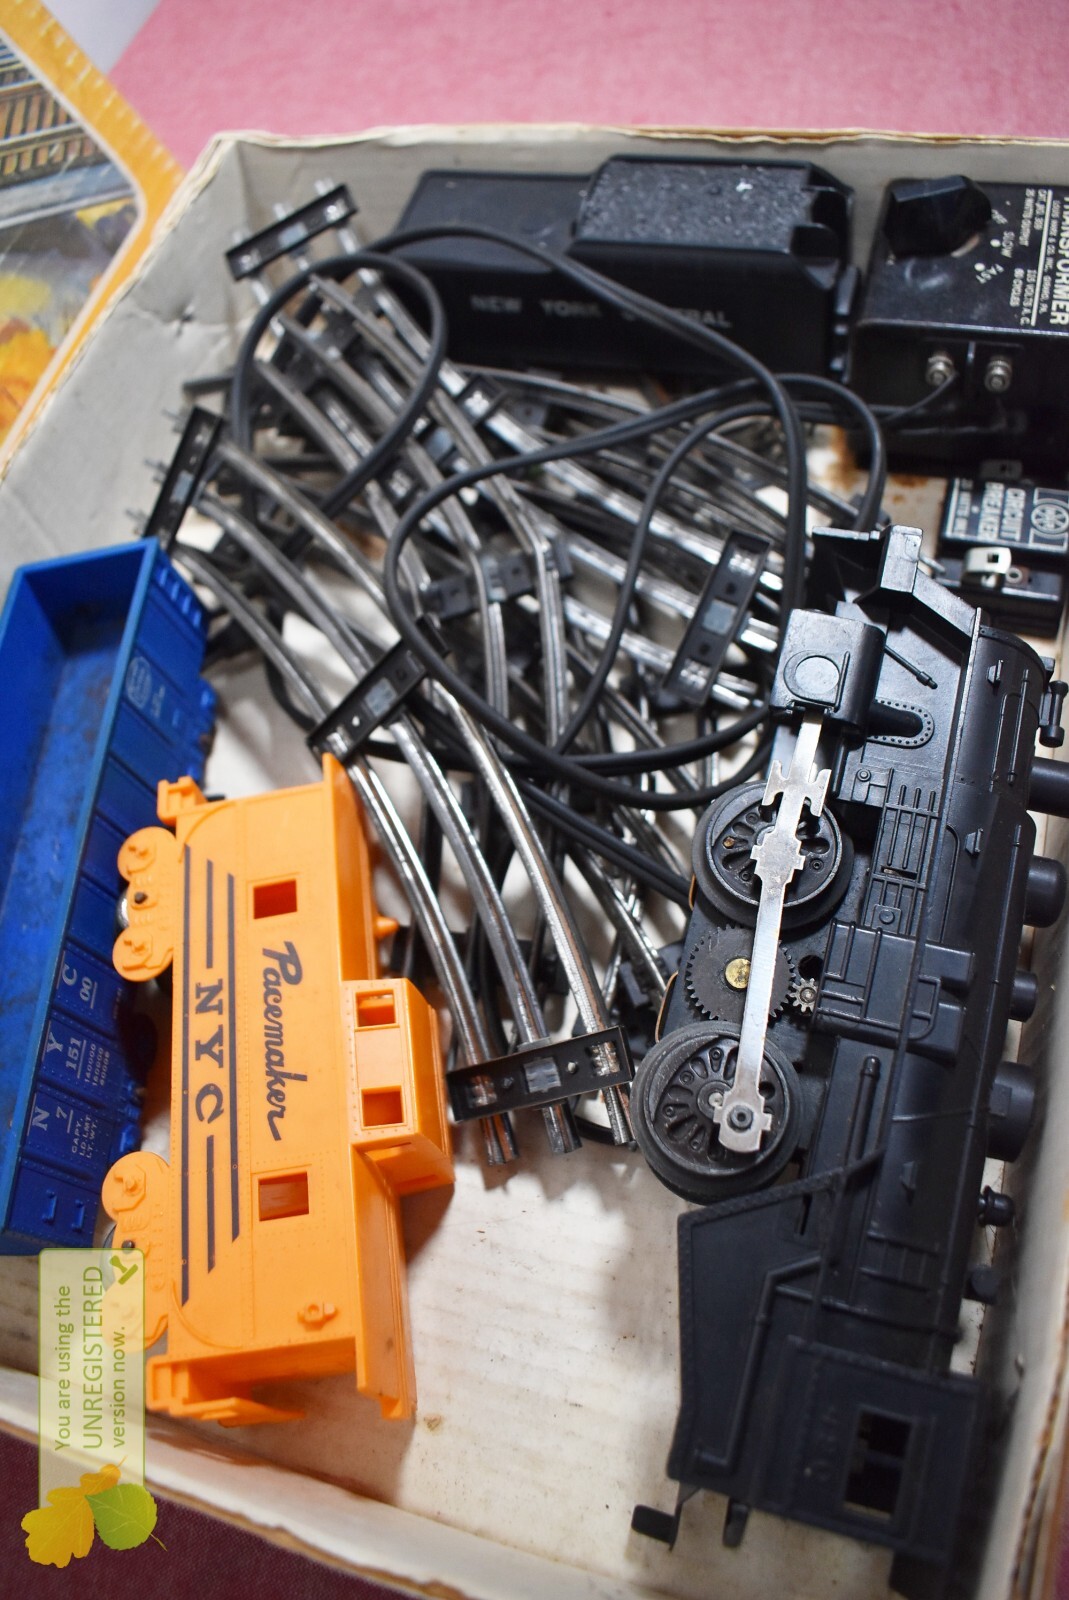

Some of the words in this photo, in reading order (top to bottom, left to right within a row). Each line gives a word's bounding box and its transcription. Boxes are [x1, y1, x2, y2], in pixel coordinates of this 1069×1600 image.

[1001, 230, 1016, 258] SLOW
[1050, 196, 1069, 325] NSFORMER
[978, 481, 1005, 540] BREAKER
[1000, 487, 1027, 541] CIRCUIT
[32, 1105, 51, 1132] N
[46, 1030, 64, 1054] Y
[61, 963, 78, 986] C
[55, 1104, 68, 1119] 7
[65, 1036, 83, 1071] 151
[78, 976, 94, 1002] 00
[193, 977, 225, 1125] NYC
[260, 941, 308, 1142] Pacemaker
